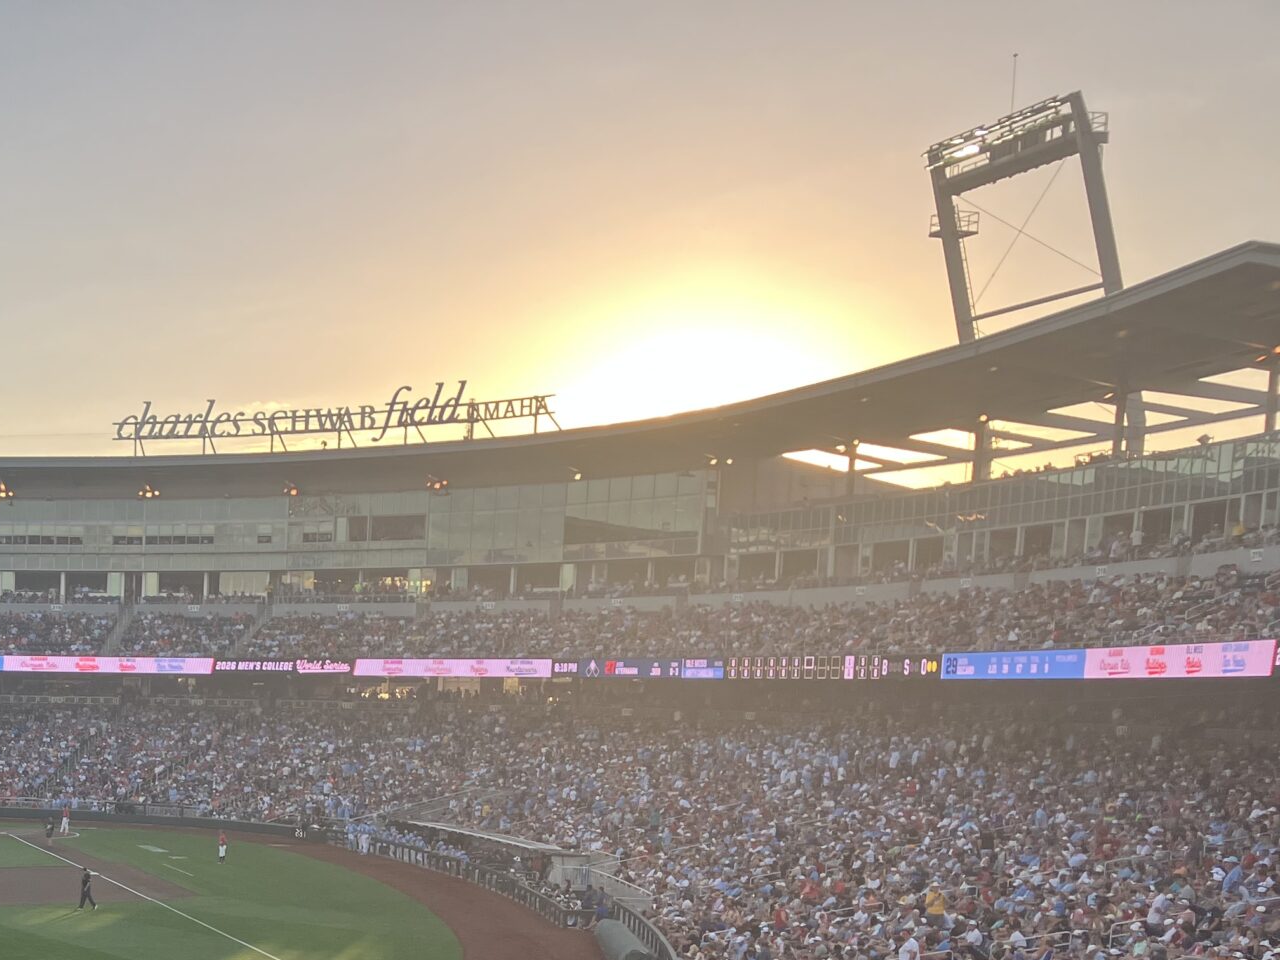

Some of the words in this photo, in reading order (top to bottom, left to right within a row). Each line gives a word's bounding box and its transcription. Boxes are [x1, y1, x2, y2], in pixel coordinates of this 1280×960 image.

[119, 400, 245, 439] charles
[251, 405, 376, 436] SCHWAB
[371, 381, 467, 441] field
[467, 395, 550, 422] OMAHA
[216, 661, 236, 670] 2026
[238, 662, 260, 670] MEN'S
[262, 662, 293, 670] COLLEGE
[296, 660, 322, 671] World
[324, 660, 350, 672] Series
[882, 659, 888, 675] B
[904, 659, 910, 675] S
[946, 658, 958, 674] 29
